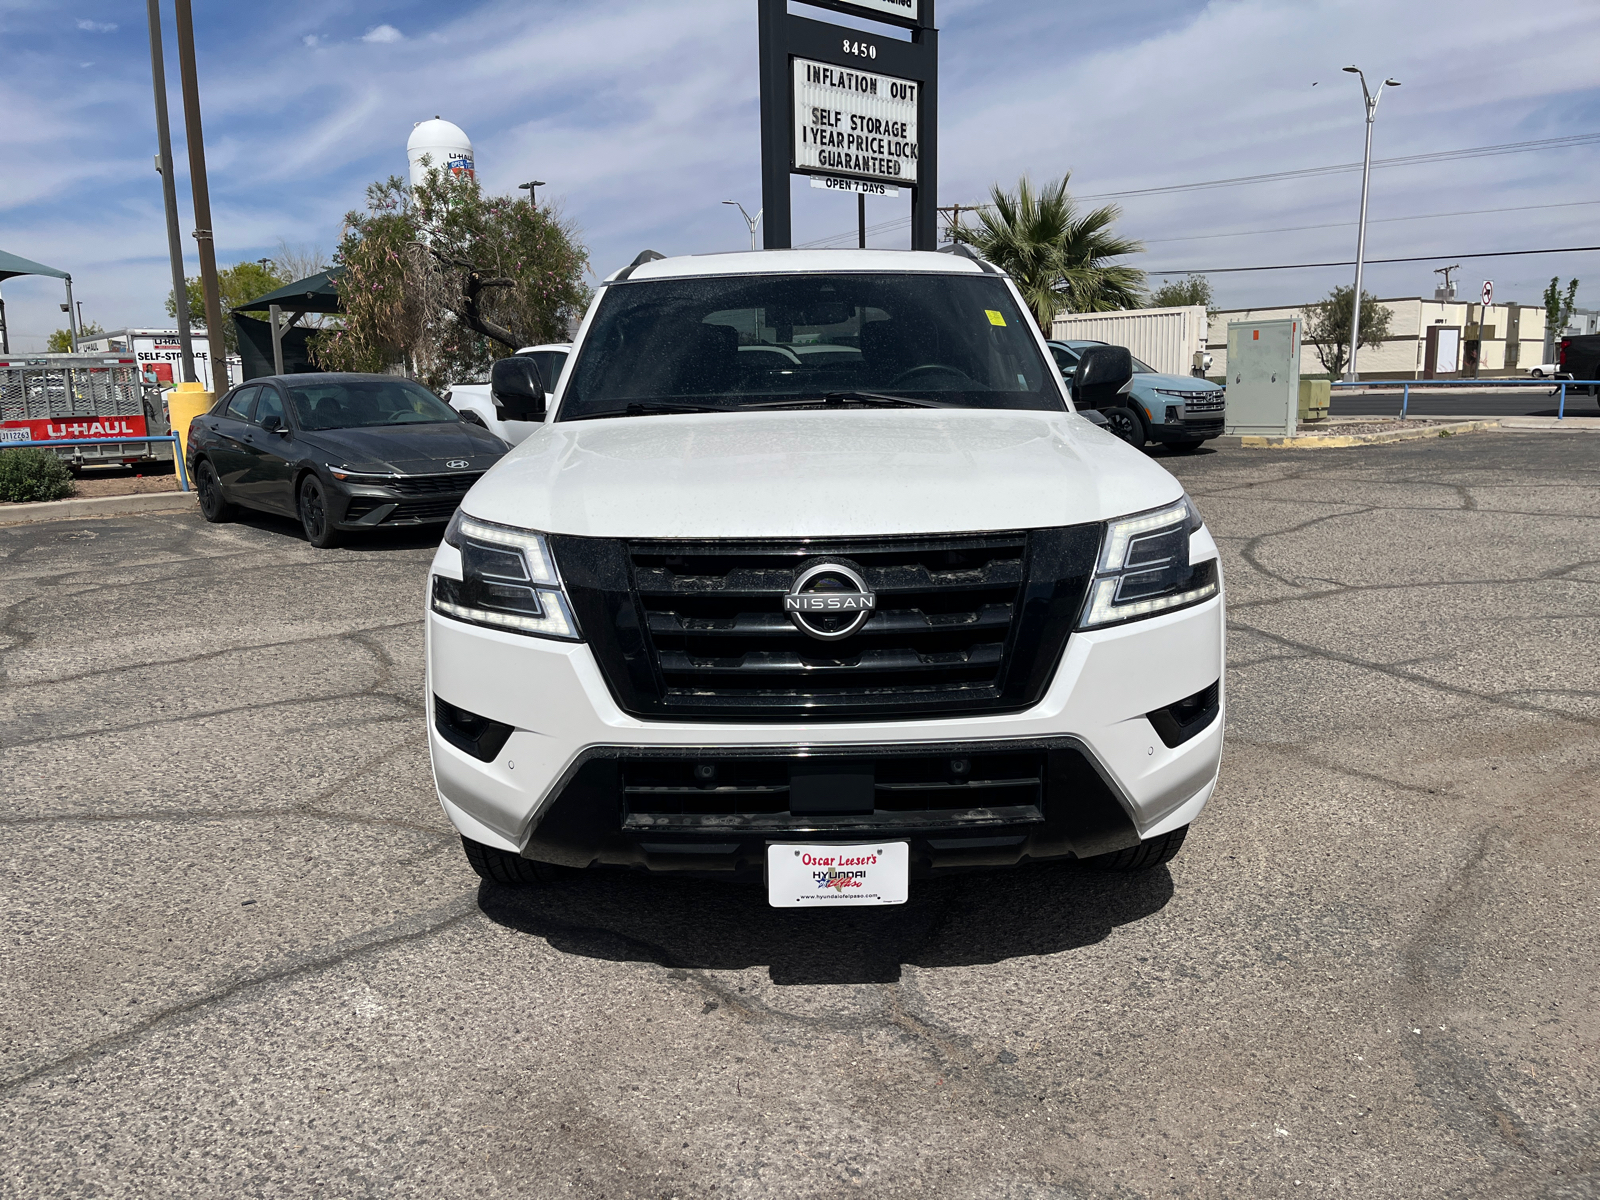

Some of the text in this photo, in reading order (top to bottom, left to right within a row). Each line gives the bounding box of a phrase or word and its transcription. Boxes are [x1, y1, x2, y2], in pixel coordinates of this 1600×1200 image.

[843, 39, 877, 59] 8450
[806, 64, 915, 101] INFLATION OUT
[811, 107, 907, 139] SELF STORAGE
[810, 128, 844, 148] YEAR
[847, 133, 884, 155] PRICE
[887, 142, 918, 160] LOCK
[818, 149, 901, 176] GUARANTEED
[825, 178, 885, 195] OPEN 7 DAYS
[47, 421, 133, 437] U-HAUL
[787, 597, 872, 609] NISSAN
[802, 853, 877, 866] Oscar Leeser's
[812, 870, 866, 879] HYUNDAI
